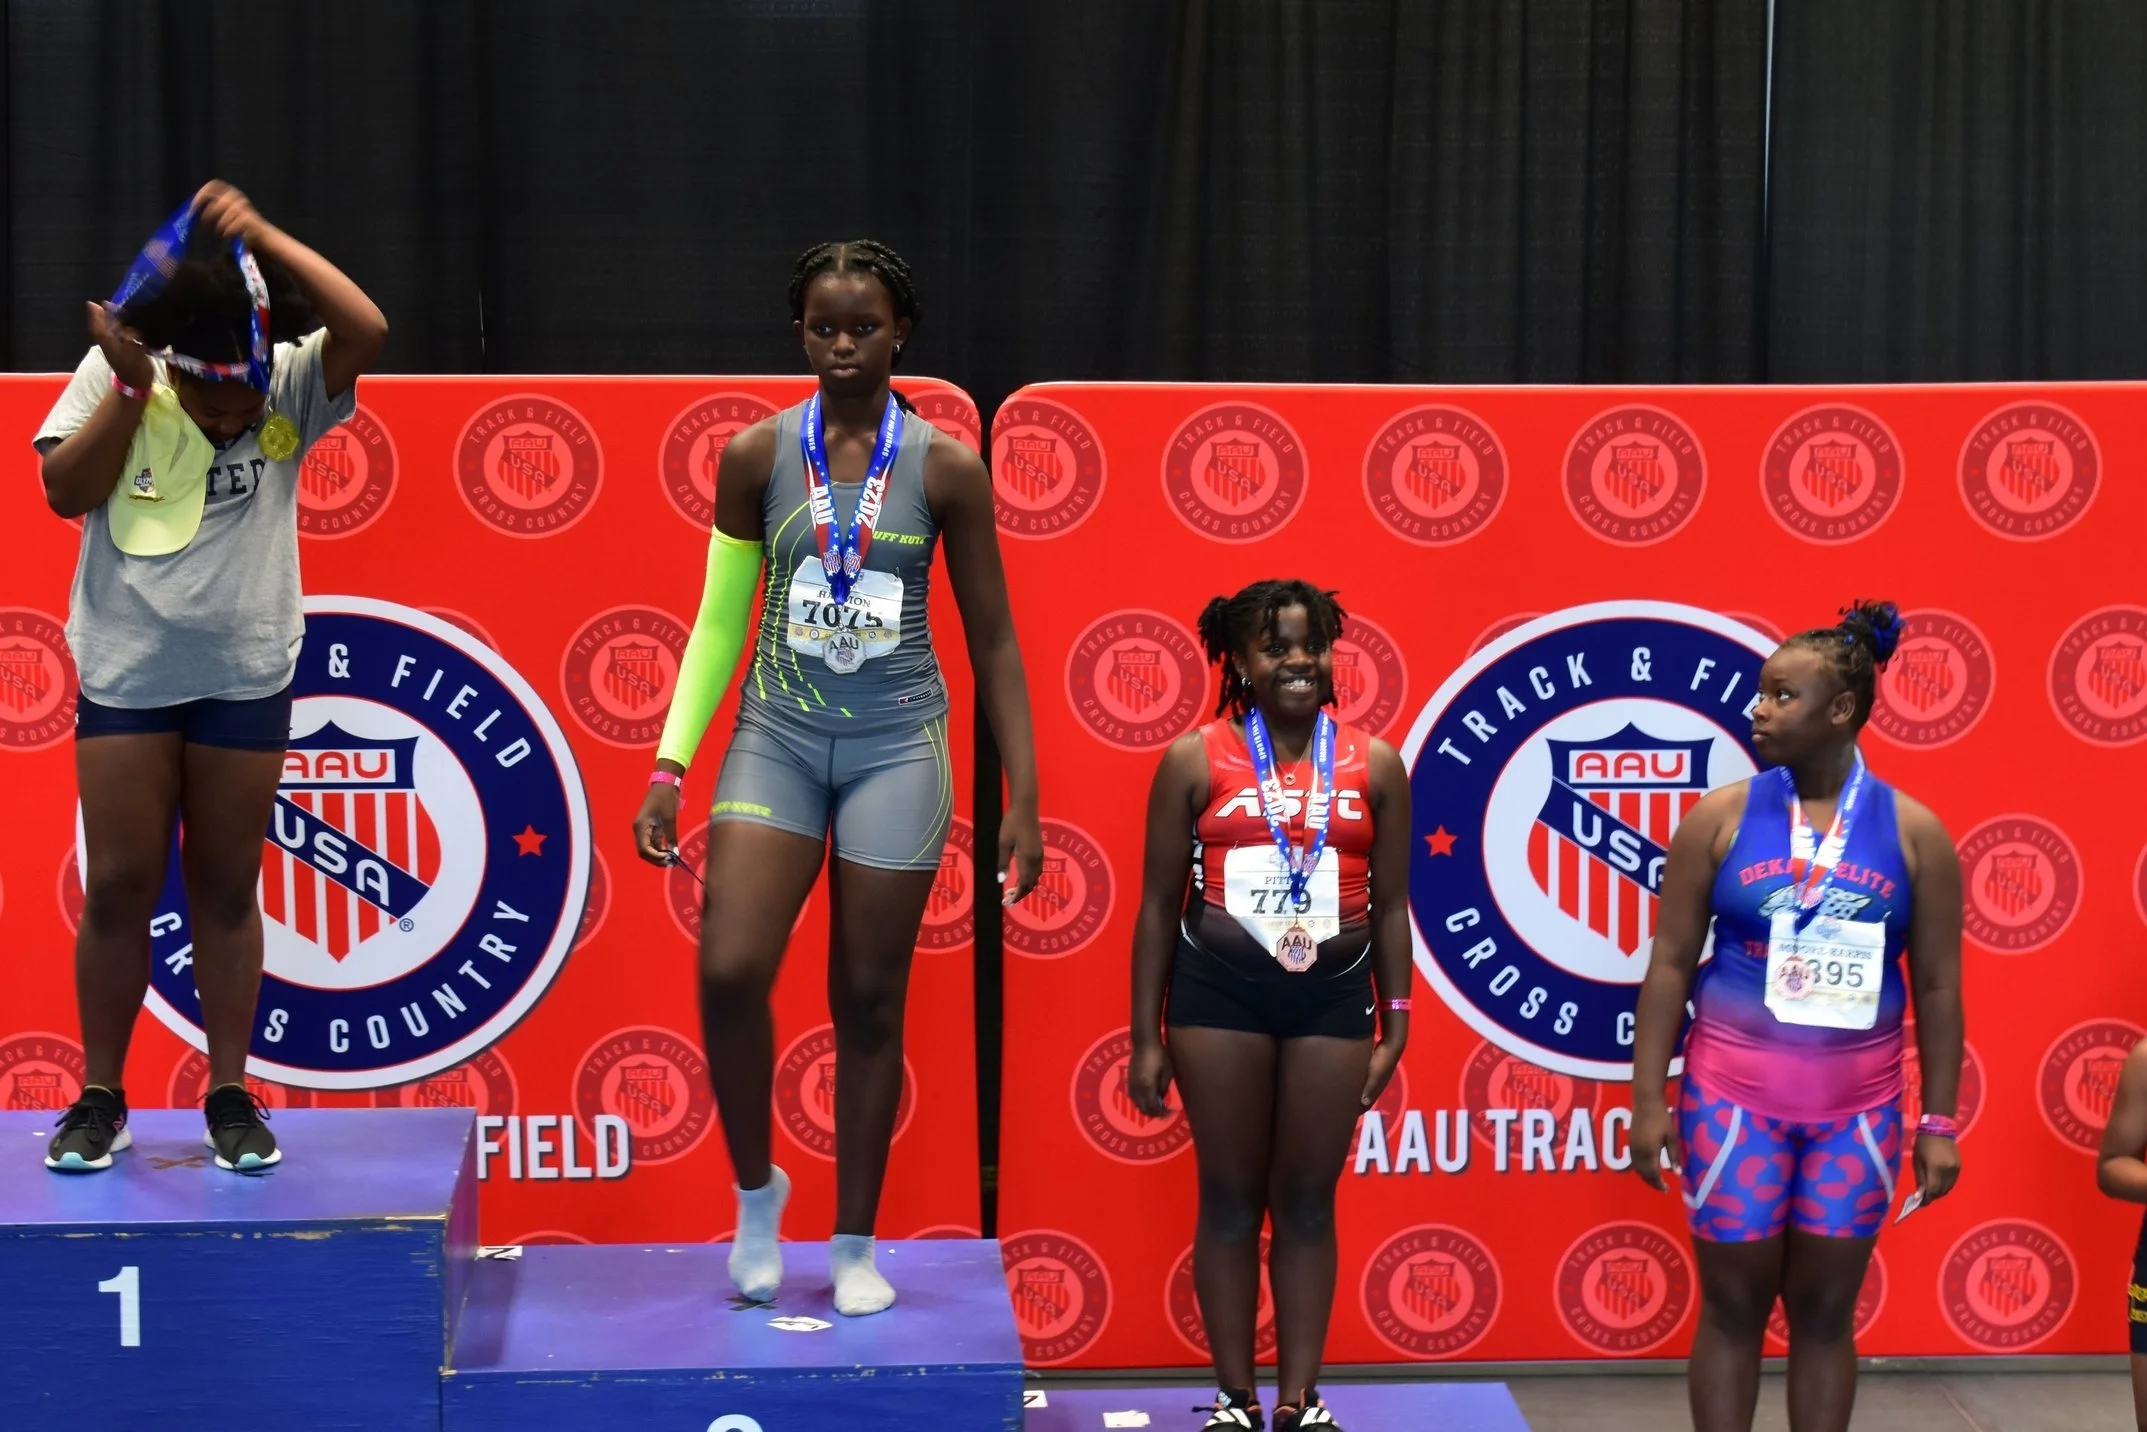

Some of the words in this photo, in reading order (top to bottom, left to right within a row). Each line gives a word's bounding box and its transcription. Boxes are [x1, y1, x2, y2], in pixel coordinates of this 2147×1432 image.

[470, 410, 516, 444] TRACK
[527, 408, 534, 418] &
[545, 411, 587, 445] FIELD
[674, 409, 720, 443] TRACK
[732, 407, 738, 417] &
[1032, 411, 1039, 421] &
[1050, 415, 1091, 449] FIELD
[1178, 417, 1224, 450] TRACK
[1235, 416, 1242, 426] &
[1253, 419, 1293, 453] FIELD
[1379, 420, 1425, 453] TRACK
[1436, 418, 1443, 429] &
[1454, 422, 1494, 455] FIELD
[1578, 420, 1624, 454] TRACK
[1635, 418, 1642, 429] &
[1653, 422, 1692, 455] FIELD
[1777, 419, 1822, 453] TRACK
[1851, 421, 1890, 453] FIELD
[1974, 417, 2020, 451] TRACK
[2048, 418, 2087, 450] FIELD
[1017, 442, 1050, 450] AAU
[1219, 447, 1252, 455] AAU
[306, 455, 340, 486] USA
[511, 455, 546, 485] USA
[1016, 456, 1049, 487] USA
[1218, 461, 1251, 492] USA
[1419, 464, 1451, 494] USA
[1618, 464, 1650, 494] USA
[322, 484, 381, 530] COUNTRY
[473, 486, 516, 526] CROSS
[527, 483, 587, 529] COUNTRY
[810, 483, 834, 525] AAU
[855, 476, 885, 529] 2023
[1030, 487, 1089, 530] COUNTRY
[1180, 492, 1220, 531] CROSS
[1231, 491, 1291, 534] COUNTRY
[1381, 495, 1421, 534] CROSS
[1431, 493, 1491, 537] COUNTRY
[1580, 495, 1620, 534] CROSS
[1630, 493, 1690, 537] COUNTRY
[1778, 494, 1818, 533] CROSS
[1828, 491, 1887, 535] COUNTRY
[1975, 492, 2015, 529] CROSS
[2025, 487, 2085, 532] COUNTRY
[872, 531, 899, 542] UFF
[16, 621, 23, 632] &
[802, 600, 883, 629] 7075
[577, 621, 622, 656] TRACK
[633, 619, 640, 629] &
[618, 650, 651, 658] AAU
[829, 637, 859, 650] AAU
[1080, 625, 1125, 658] TRACK
[1136, 623, 1143, 634] &
[1154, 627, 1194, 660] FIELD
[1944, 626, 1981, 658] FIELD
[617, 666, 650, 695] USA
[1120, 669, 1154, 699] USA
[18, 698, 79, 742] COUNTRY
[329, 643, 350, 678] &
[391, 655, 531, 767] FIELD
[580, 698, 621, 736] CROSS
[1084, 700, 1124, 739] CROSS
[1135, 698, 1193, 742] COUNTRY
[1438, 652, 1592, 765] TRACK
[1631, 647, 1652, 681] &
[1919, 695, 1978, 740] COUNTRY
[282, 752, 387, 778] AAU
[1576, 752, 1683, 778] AAU
[1215, 787, 1362, 820] ASC
[1261, 779, 1290, 828] 2023
[1306, 792, 1330, 829] AAU
[275, 802, 389, 907] USA
[1059, 835, 1099, 868] FIELD
[1961, 830, 2005, 863] TRACK
[2032, 831, 2069, 864] FIELD
[1834, 861, 1896, 899] ELITE
[1250, 889, 1311, 914] 779
[1042, 905, 1099, 950] COUNTRY
[1961, 904, 1999, 942] CROSS
[2009, 901, 2066, 945] COUNTRY
[1281, 935, 1312, 950] AAU
[150, 912, 289, 1042] CRS
[330, 900, 529, 1053] COUNTRY
[1446, 908, 1578, 1035] CROSS
[1805, 959, 1864, 988] 395
[587, 1041, 632, 1075] TRACK
[643, 1040, 650, 1050] &
[661, 1043, 702, 1075] FIELD
[787, 1038, 831, 1072] TRACK
[2052, 1034, 2095, 1068] TRACK
[644, 1112, 702, 1156] COUNTRY
[791, 1113, 832, 1150] CROSS
[1089, 1115, 1127, 1153] CROSS
[1354, 1110, 1468, 1174] AAU
[1486, 1107, 1672, 1172] TRAC
[2054, 1107, 2093, 1144] CROSS
[476, 1115, 629, 1179] FIELD
[1059, 1247, 1098, 1279] FIELD
[1376, 1240, 1420, 1272] TRACK
[1449, 1241, 1488, 1271] FIELD
[98, 1266, 140, 1347] 1
[1036, 1315, 1095, 1357] COUNTRY
[1378, 1310, 1418, 1346] CROSS
[1429, 1306, 1486, 1348] COUNTRY
